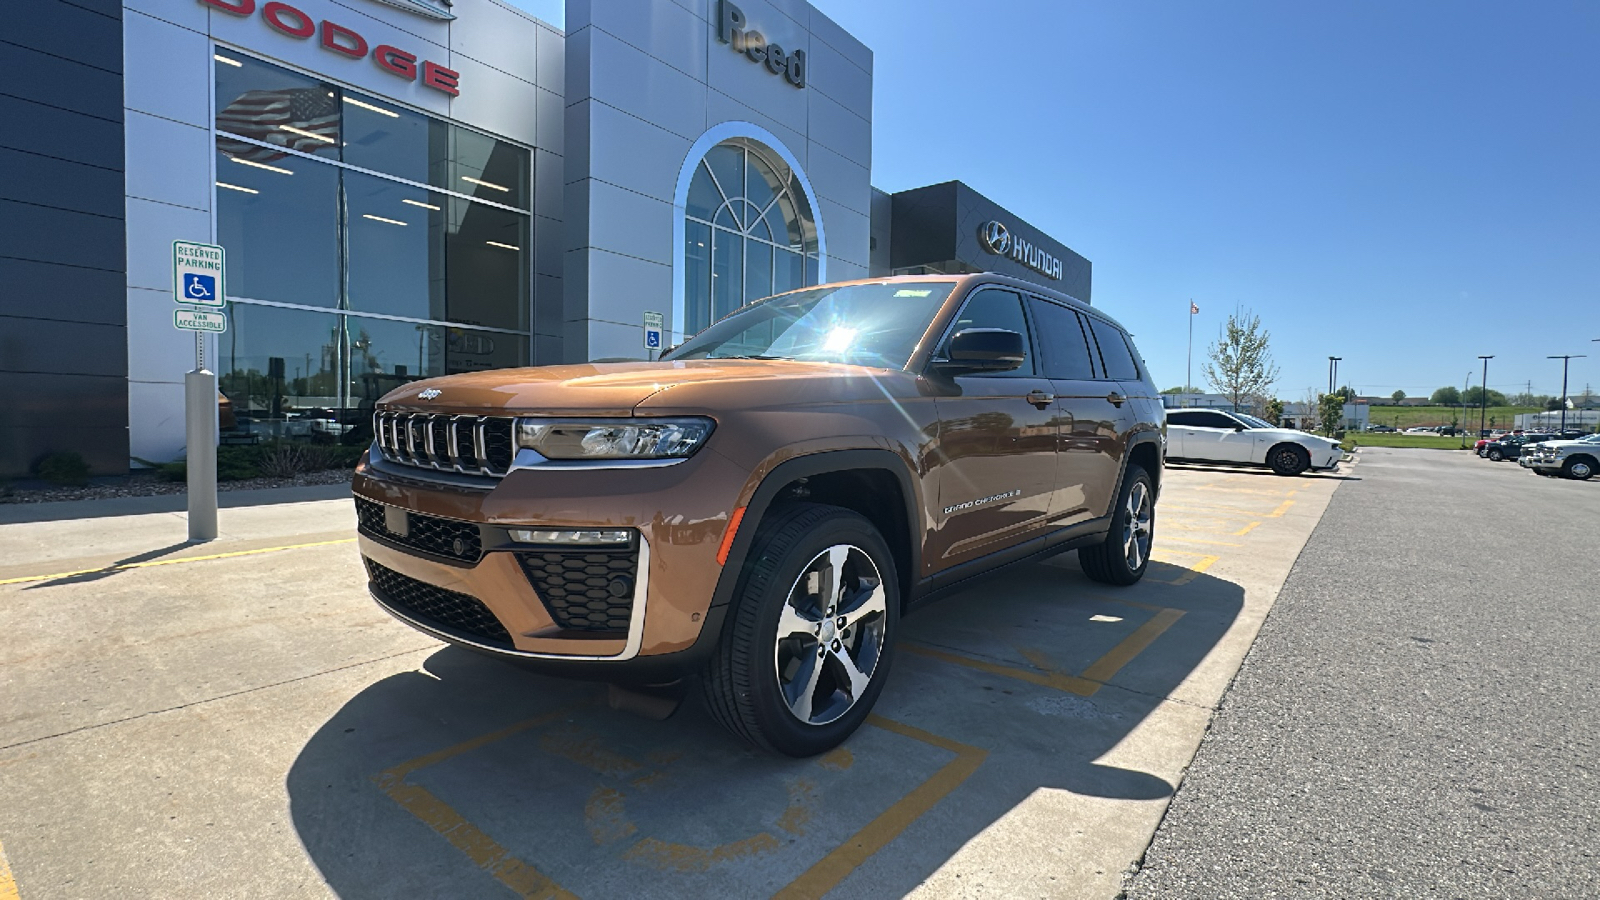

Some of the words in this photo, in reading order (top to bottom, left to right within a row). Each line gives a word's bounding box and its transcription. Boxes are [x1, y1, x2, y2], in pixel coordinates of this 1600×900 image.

[718, 0, 806, 89] Reed
[178, 246, 220, 260] RESERVED
[1012, 235, 1063, 281] HYUNDAI
[178, 257, 221, 271] PARKING
[178, 319, 222, 329] ACCESSIBLE
[193, 313, 208, 321] VAN
